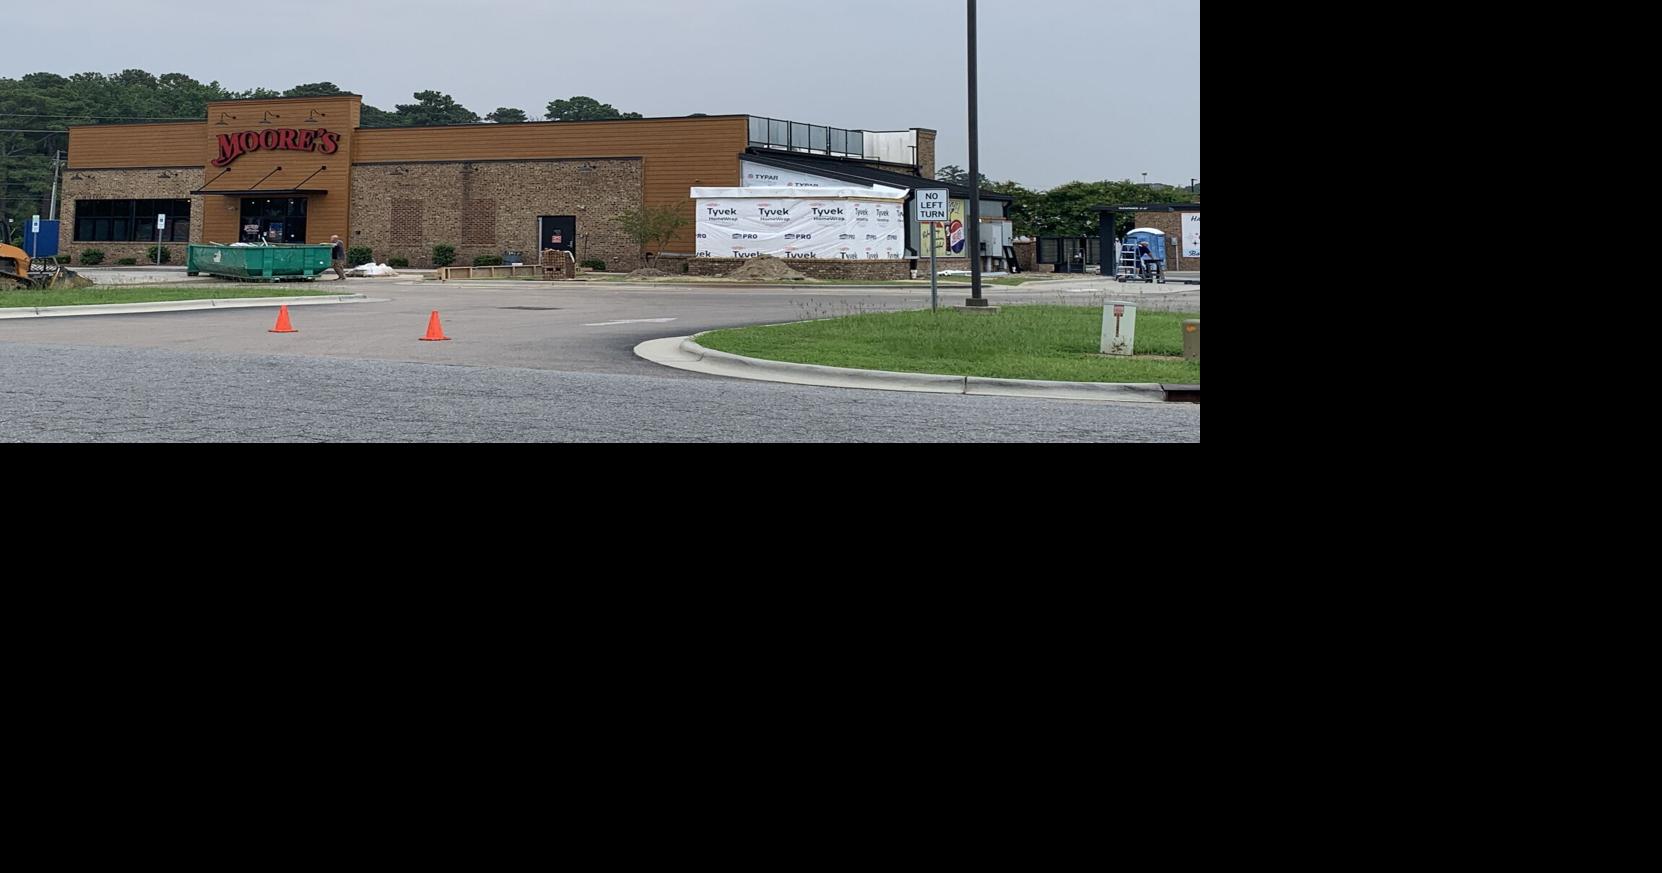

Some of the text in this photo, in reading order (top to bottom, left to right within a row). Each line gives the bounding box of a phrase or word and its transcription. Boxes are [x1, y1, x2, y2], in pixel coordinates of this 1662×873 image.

[210, 128, 341, 168] MOORE'S
[925, 192, 938, 200] NO
[920, 201, 943, 209] LEFT
[707, 208, 737, 216] Tyvek
[758, 208, 789, 217] Tyvek
[811, 207, 843, 216] Tyvek
[855, 207, 869, 216] Tyvek
[876, 209, 889, 217] Tyvek
[920, 210, 945, 218] TURN
[785, 251, 816, 259] Tyvek
